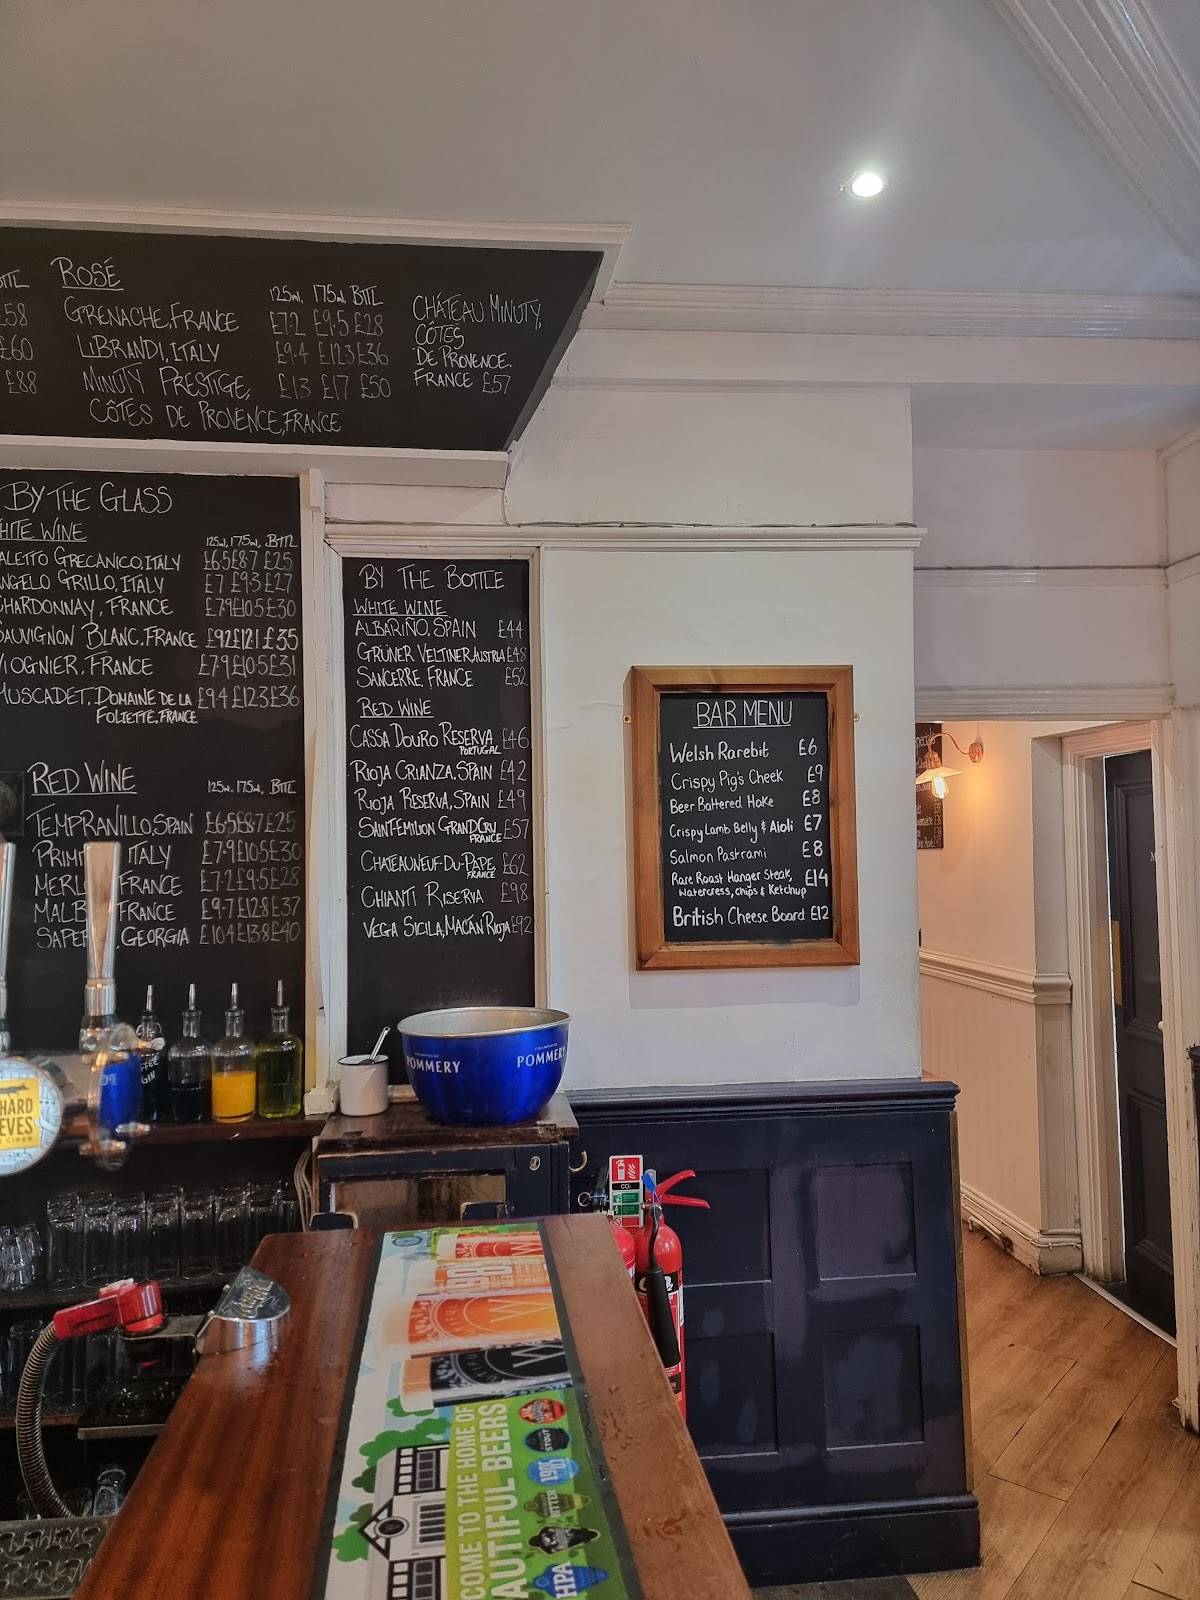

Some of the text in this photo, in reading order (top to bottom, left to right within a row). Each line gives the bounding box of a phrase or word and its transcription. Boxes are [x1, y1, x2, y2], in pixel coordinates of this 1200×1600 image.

[50, 257, 121, 288] ROSÉ
[354, 312, 384, 336] £28
[357, 342, 389, 366] £36
[416, 346, 438, 366] DE
[6, 370, 37, 394] £88
[279, 373, 391, 400] £13 £17 £50
[414, 368, 511, 394] FRANCE £57
[166, 405, 191, 428] DE
[0, 481, 173, 513] BY THE GLASS
[0, 517, 87, 541] HITE WINE
[120, 573, 164, 593] ITALY
[205, 572, 293, 594] £7 £27
[359, 563, 505, 590] BY THE BOTTLE
[106, 595, 174, 616] FRANCE
[353, 598, 447, 616] WHITE WINE
[262, 626, 299, 651] £35
[433, 616, 524, 639] SPAIN £44
[84, 650, 154, 676] FRANCE
[269, 653, 296, 677] £31
[506, 646, 527, 663] £48
[427, 664, 475, 688] FRANCE
[505, 666, 529, 687] £52
[158, 691, 177, 706] DE
[179, 692, 193, 706] LA
[357, 696, 432, 717] RED WINE
[696, 699, 793, 727] BAR MENU
[350, 721, 530, 750] CASSA DOURO RESERVA £46
[458, 745, 502, 756] PORTUGAL
[669, 737, 818, 764] Welsh Rarebit £6
[27, 760, 136, 794] RED WINE
[350, 760, 392, 787] RIOJA
[456, 760, 493, 781] SPAIN
[500, 759, 528, 785] £42
[671, 763, 824, 793] Crispy Pig's Cheek £9
[353, 787, 395, 815] RIOJA
[453, 789, 490, 809] SPAIN
[497, 788, 527, 811] £49
[670, 788, 821, 814] Beer Battered Hake £8
[469, 833, 503, 844] FRANCE
[503, 818, 530, 840] £57
[669, 823, 704, 843] Crispy
[704, 823, 731, 836] Lamb
[733, 821, 758, 843] Belly
[804, 813, 823, 832] £7
[128, 840, 172, 870] ITALY
[502, 852, 529, 876] £62
[669, 840, 824, 865] Salmon Pastrami £8
[117, 869, 182, 896] FRANCE
[466, 870, 496, 880] FRANCE
[671, 871, 694, 886] Rare
[696, 871, 724, 884] Roast
[727, 870, 761, 888] Hanger
[804, 868, 829, 887] £14
[361, 881, 529, 908] CHIANTI RISERVA £98
[768, 884, 807, 899] Ketchup
[116, 900, 177, 922] FRANCE
[672, 905, 830, 927] British Cheese Board £12
[363, 917, 399, 939] VEGA
[511, 915, 533, 936] £92
[406, 1055, 461, 1074] POMMERY
[454, 1406, 476, 1422] OF
[455, 1424, 478, 1468] HOME
[479, 1403, 514, 1471] BEERS
[543, 1428, 552, 1452] STOUT
[456, 1473, 479, 1507] THE
[457, 1511, 480, 1537] TO
[554, 1561, 577, 1599] HPA
